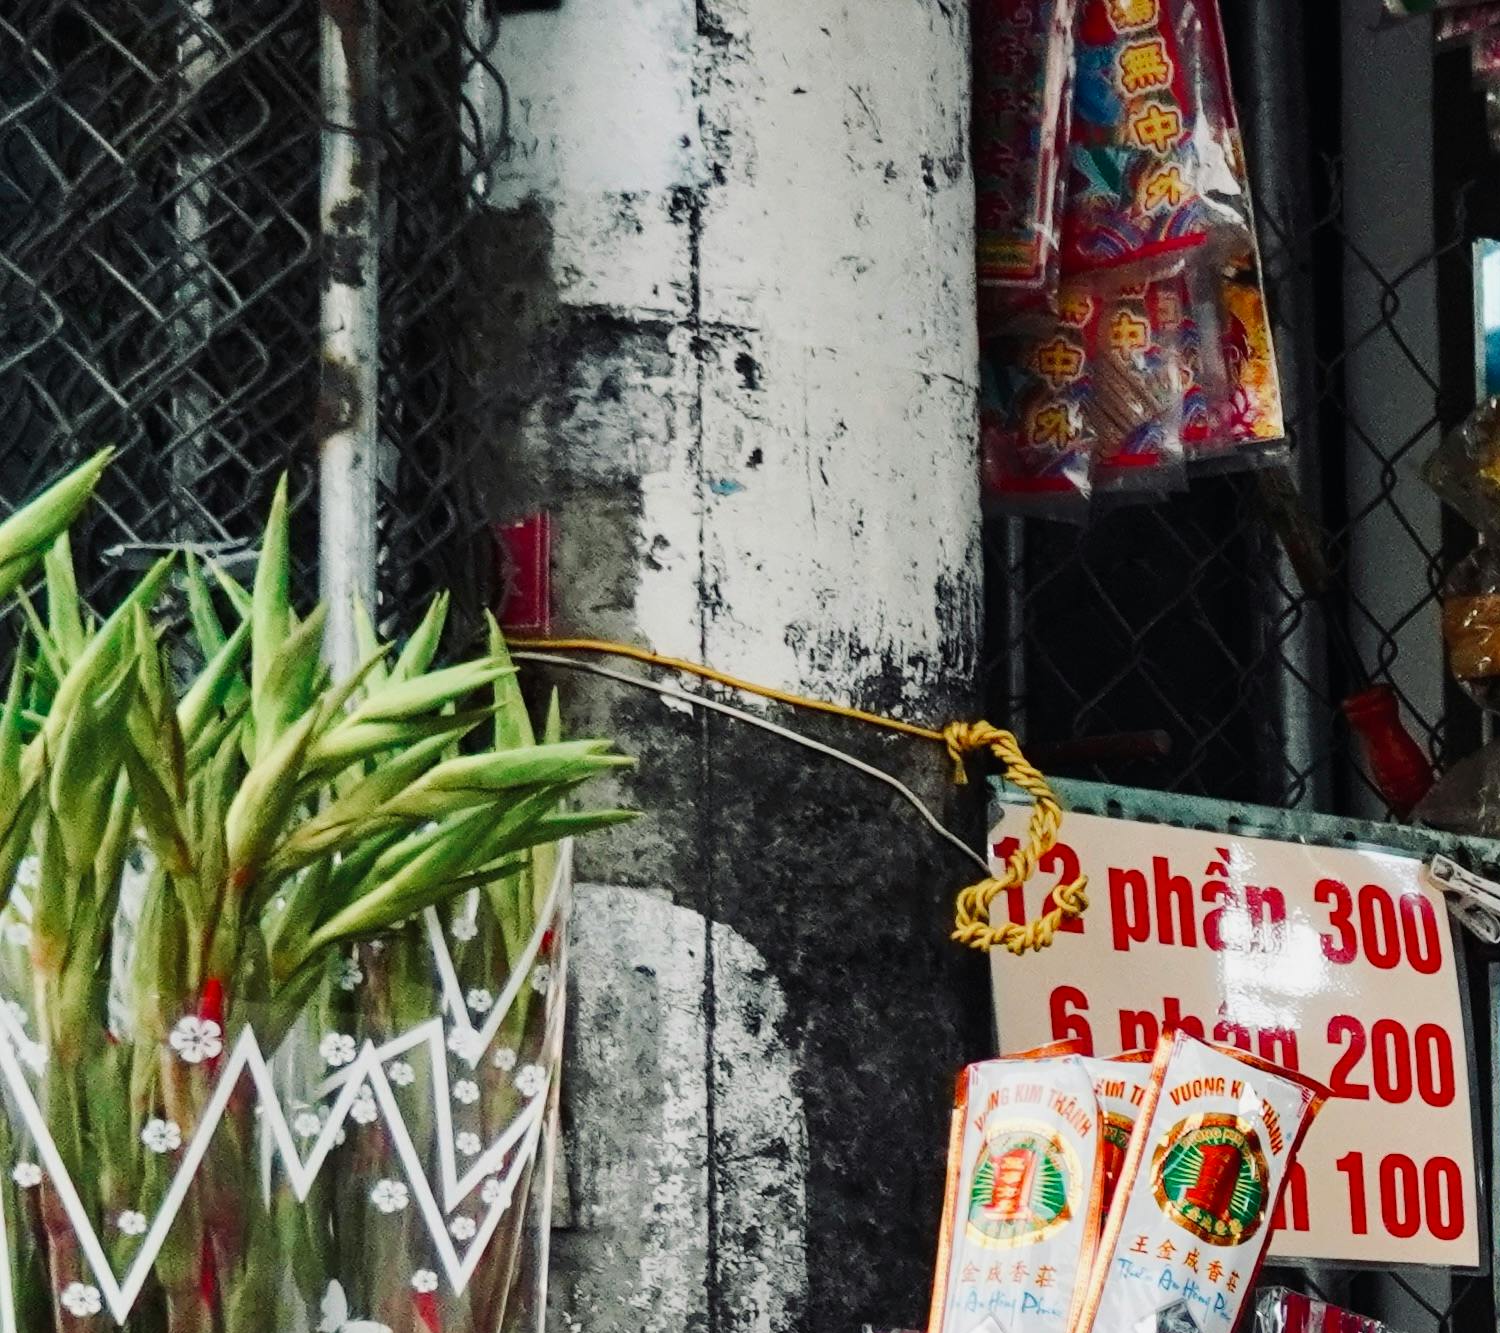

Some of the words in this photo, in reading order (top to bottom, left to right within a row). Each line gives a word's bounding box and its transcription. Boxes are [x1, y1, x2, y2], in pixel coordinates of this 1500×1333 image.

[1313, 877, 1442, 974] 300
[1327, 1014, 1456, 1108] 200
[1336, 1150, 1463, 1241] 100
